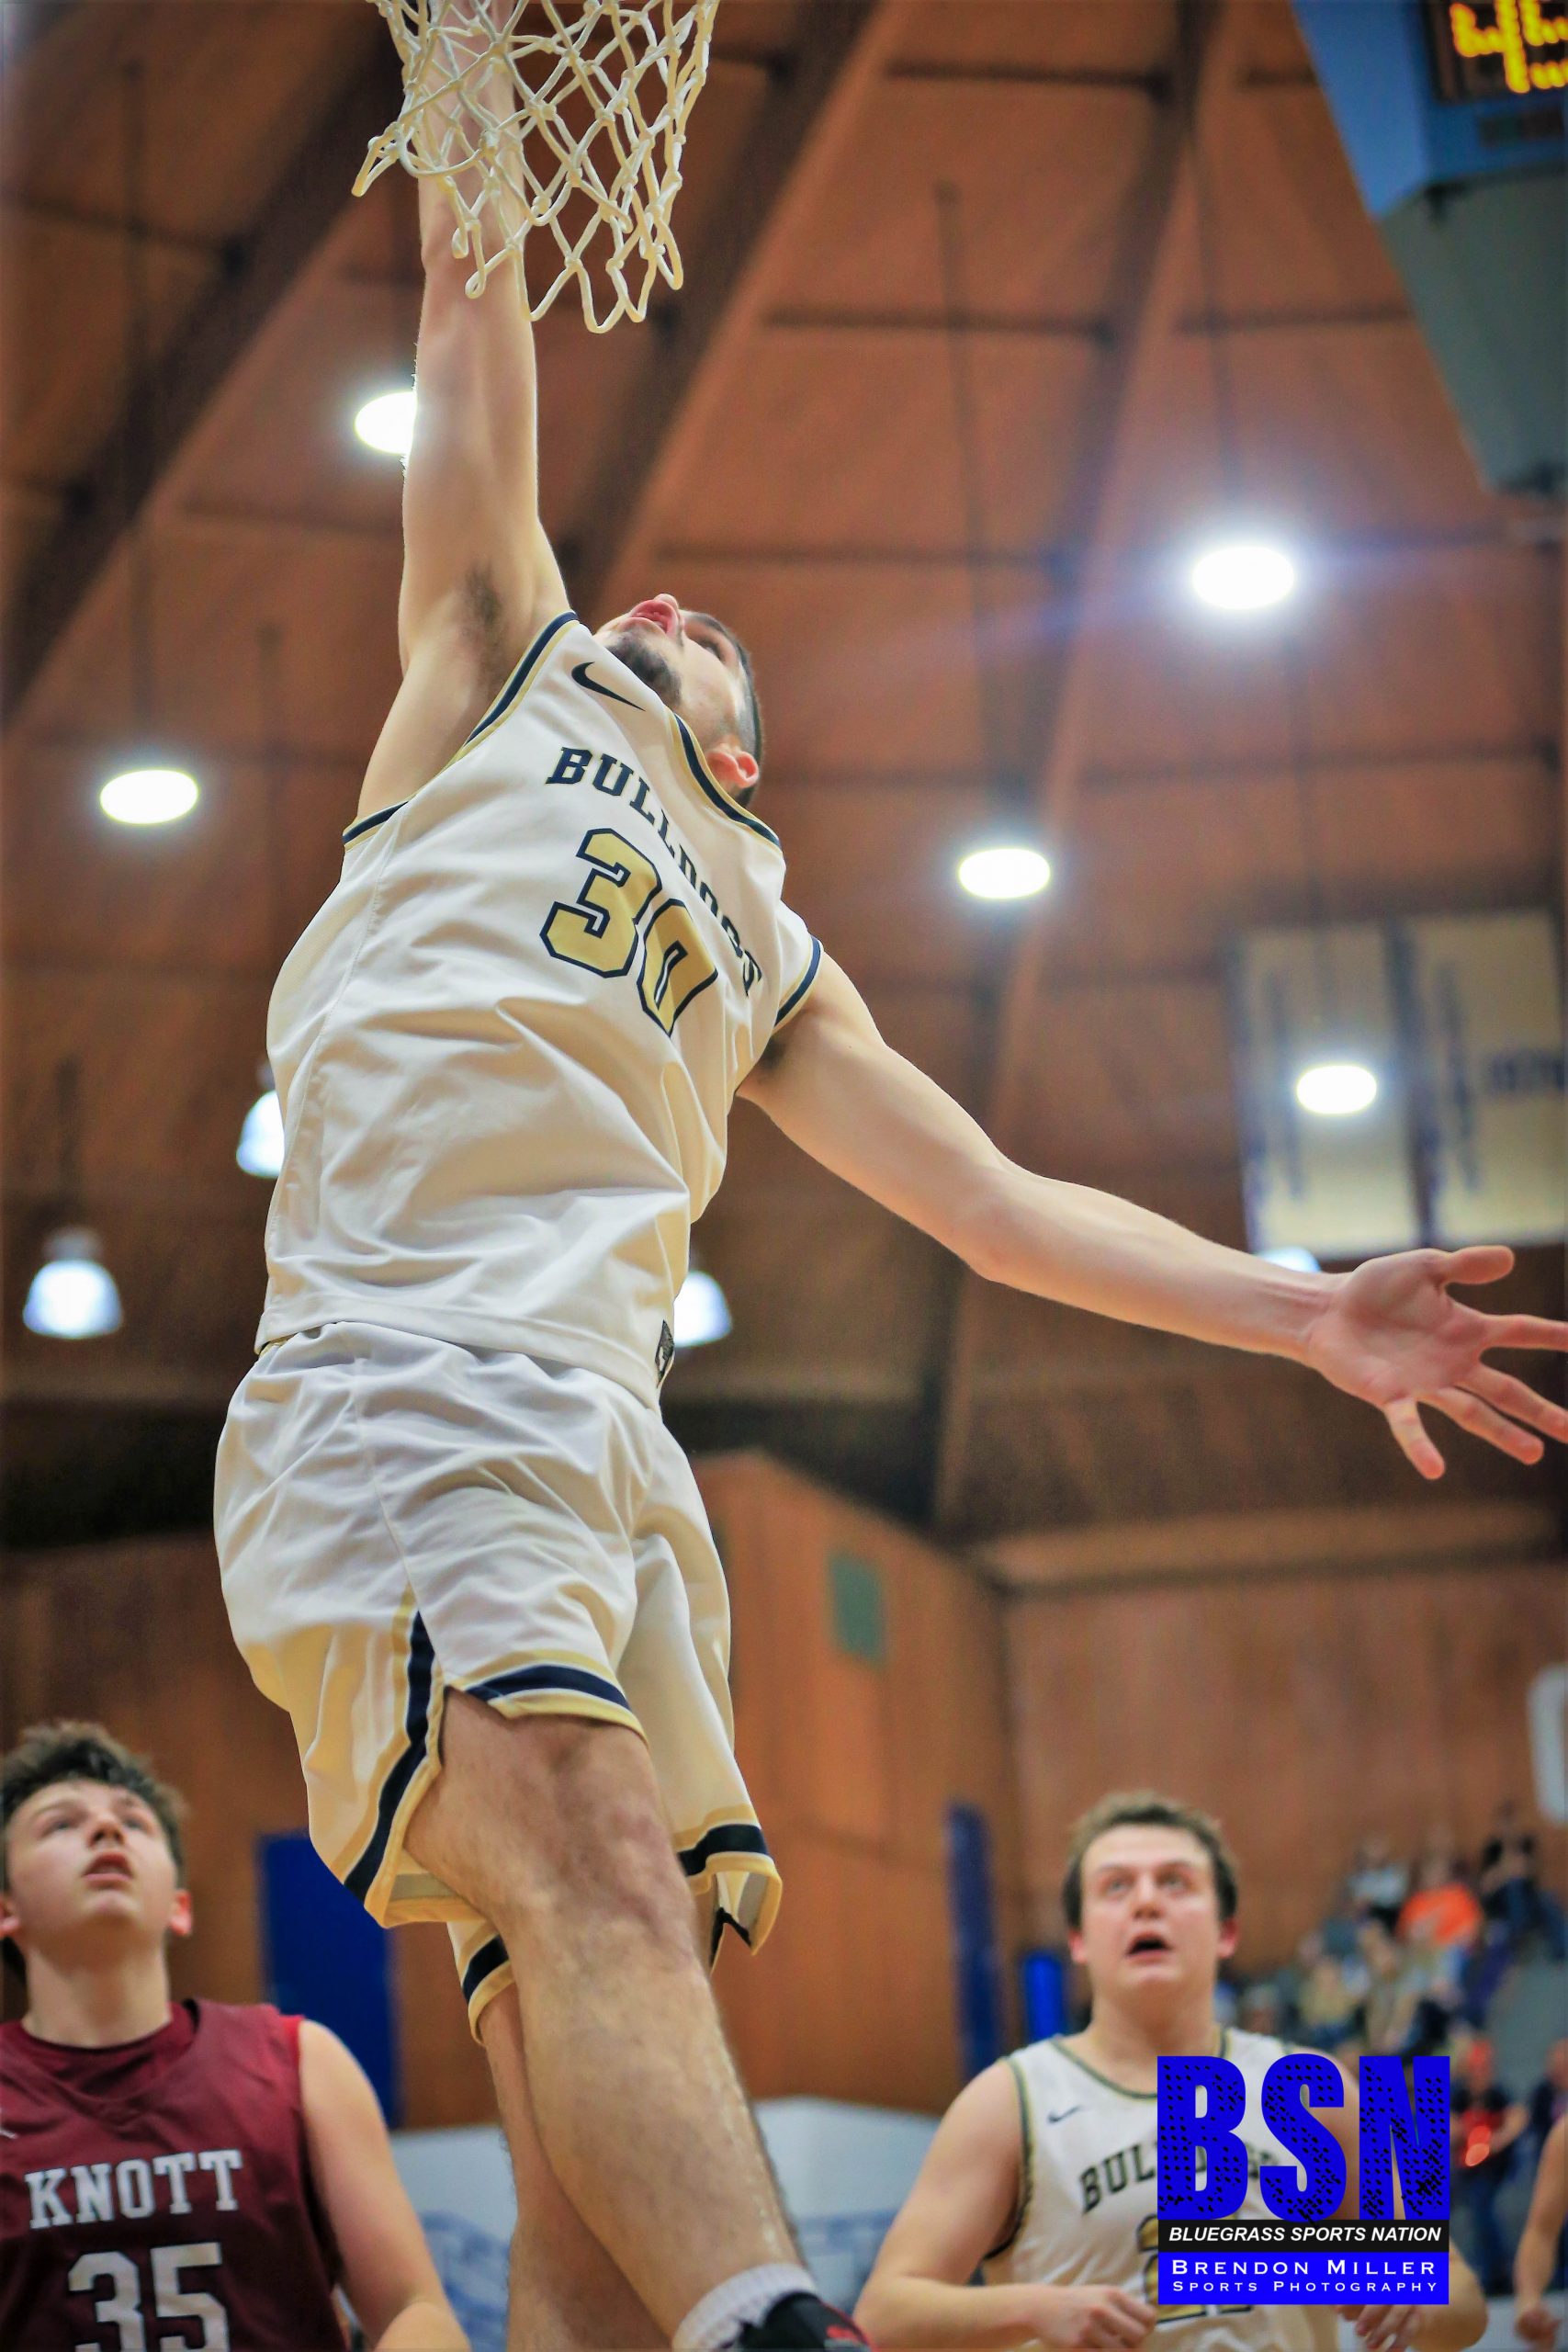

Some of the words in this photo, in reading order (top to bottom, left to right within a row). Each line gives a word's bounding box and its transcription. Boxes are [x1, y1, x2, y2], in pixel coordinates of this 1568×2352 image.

[539, 828, 718, 1037] 30
[25, 2149, 243, 2229] KNOTT
[68, 2242, 231, 2352] 35
